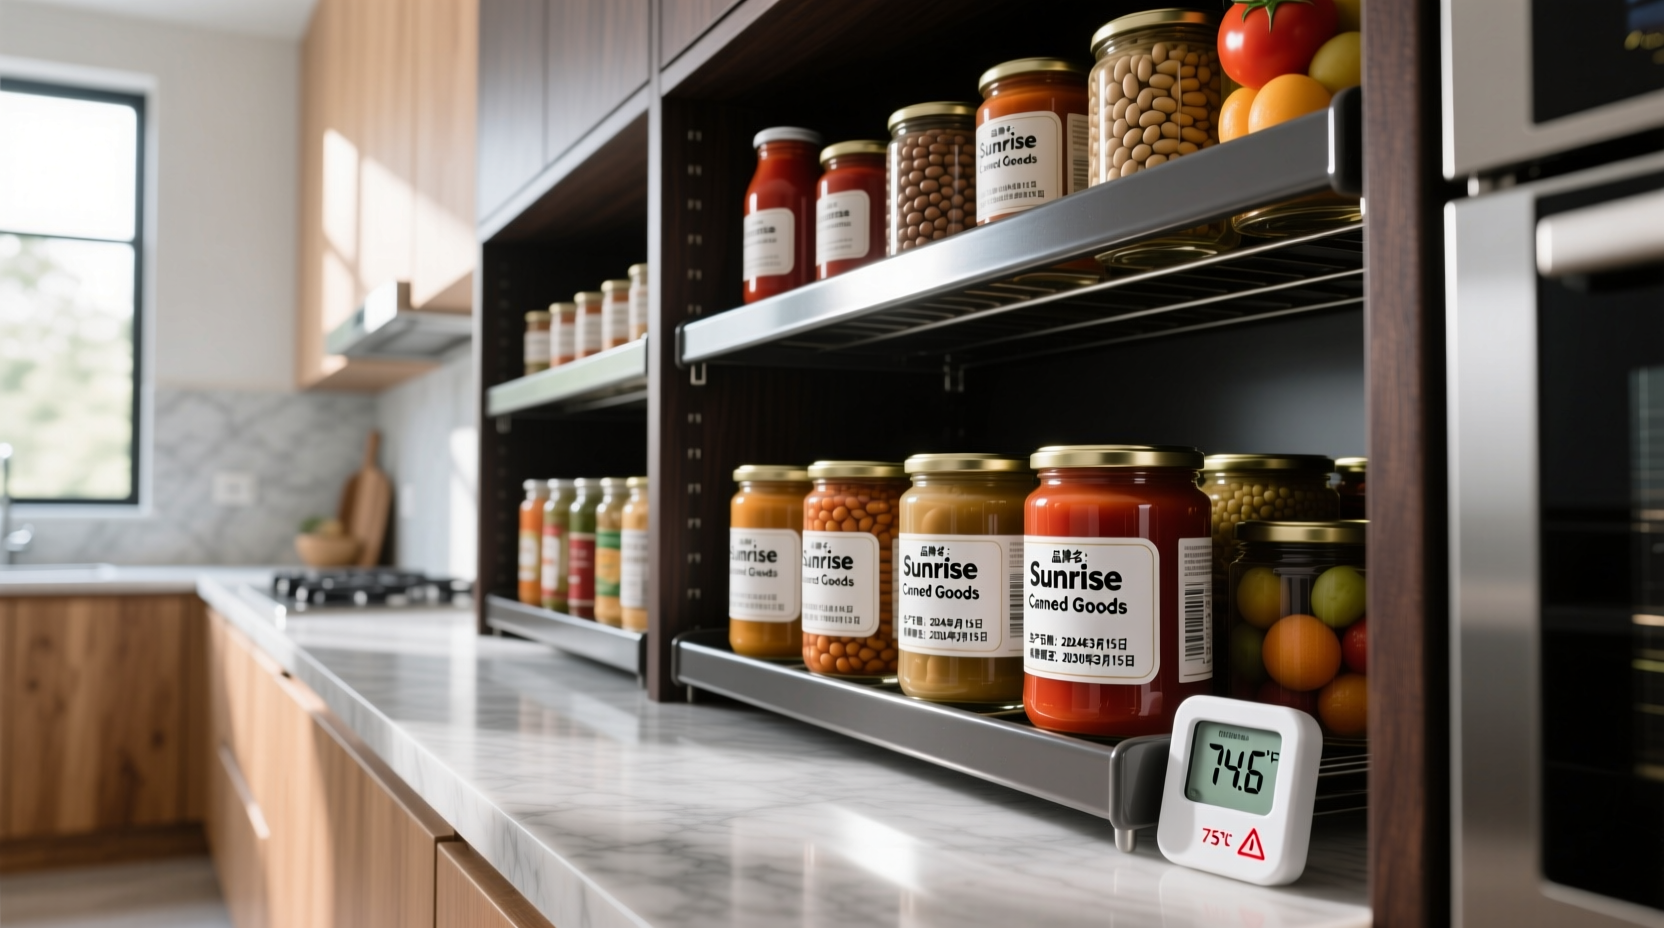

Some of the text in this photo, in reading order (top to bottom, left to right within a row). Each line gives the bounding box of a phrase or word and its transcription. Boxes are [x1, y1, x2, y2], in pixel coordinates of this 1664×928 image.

[980, 132, 1037, 158] Sunrise
[903, 554, 978, 580] Sunrise
[1030, 560, 1123, 591] Sunrise
[935, 585, 980, 600] Goods
[1072, 597, 1128, 615] Goods
